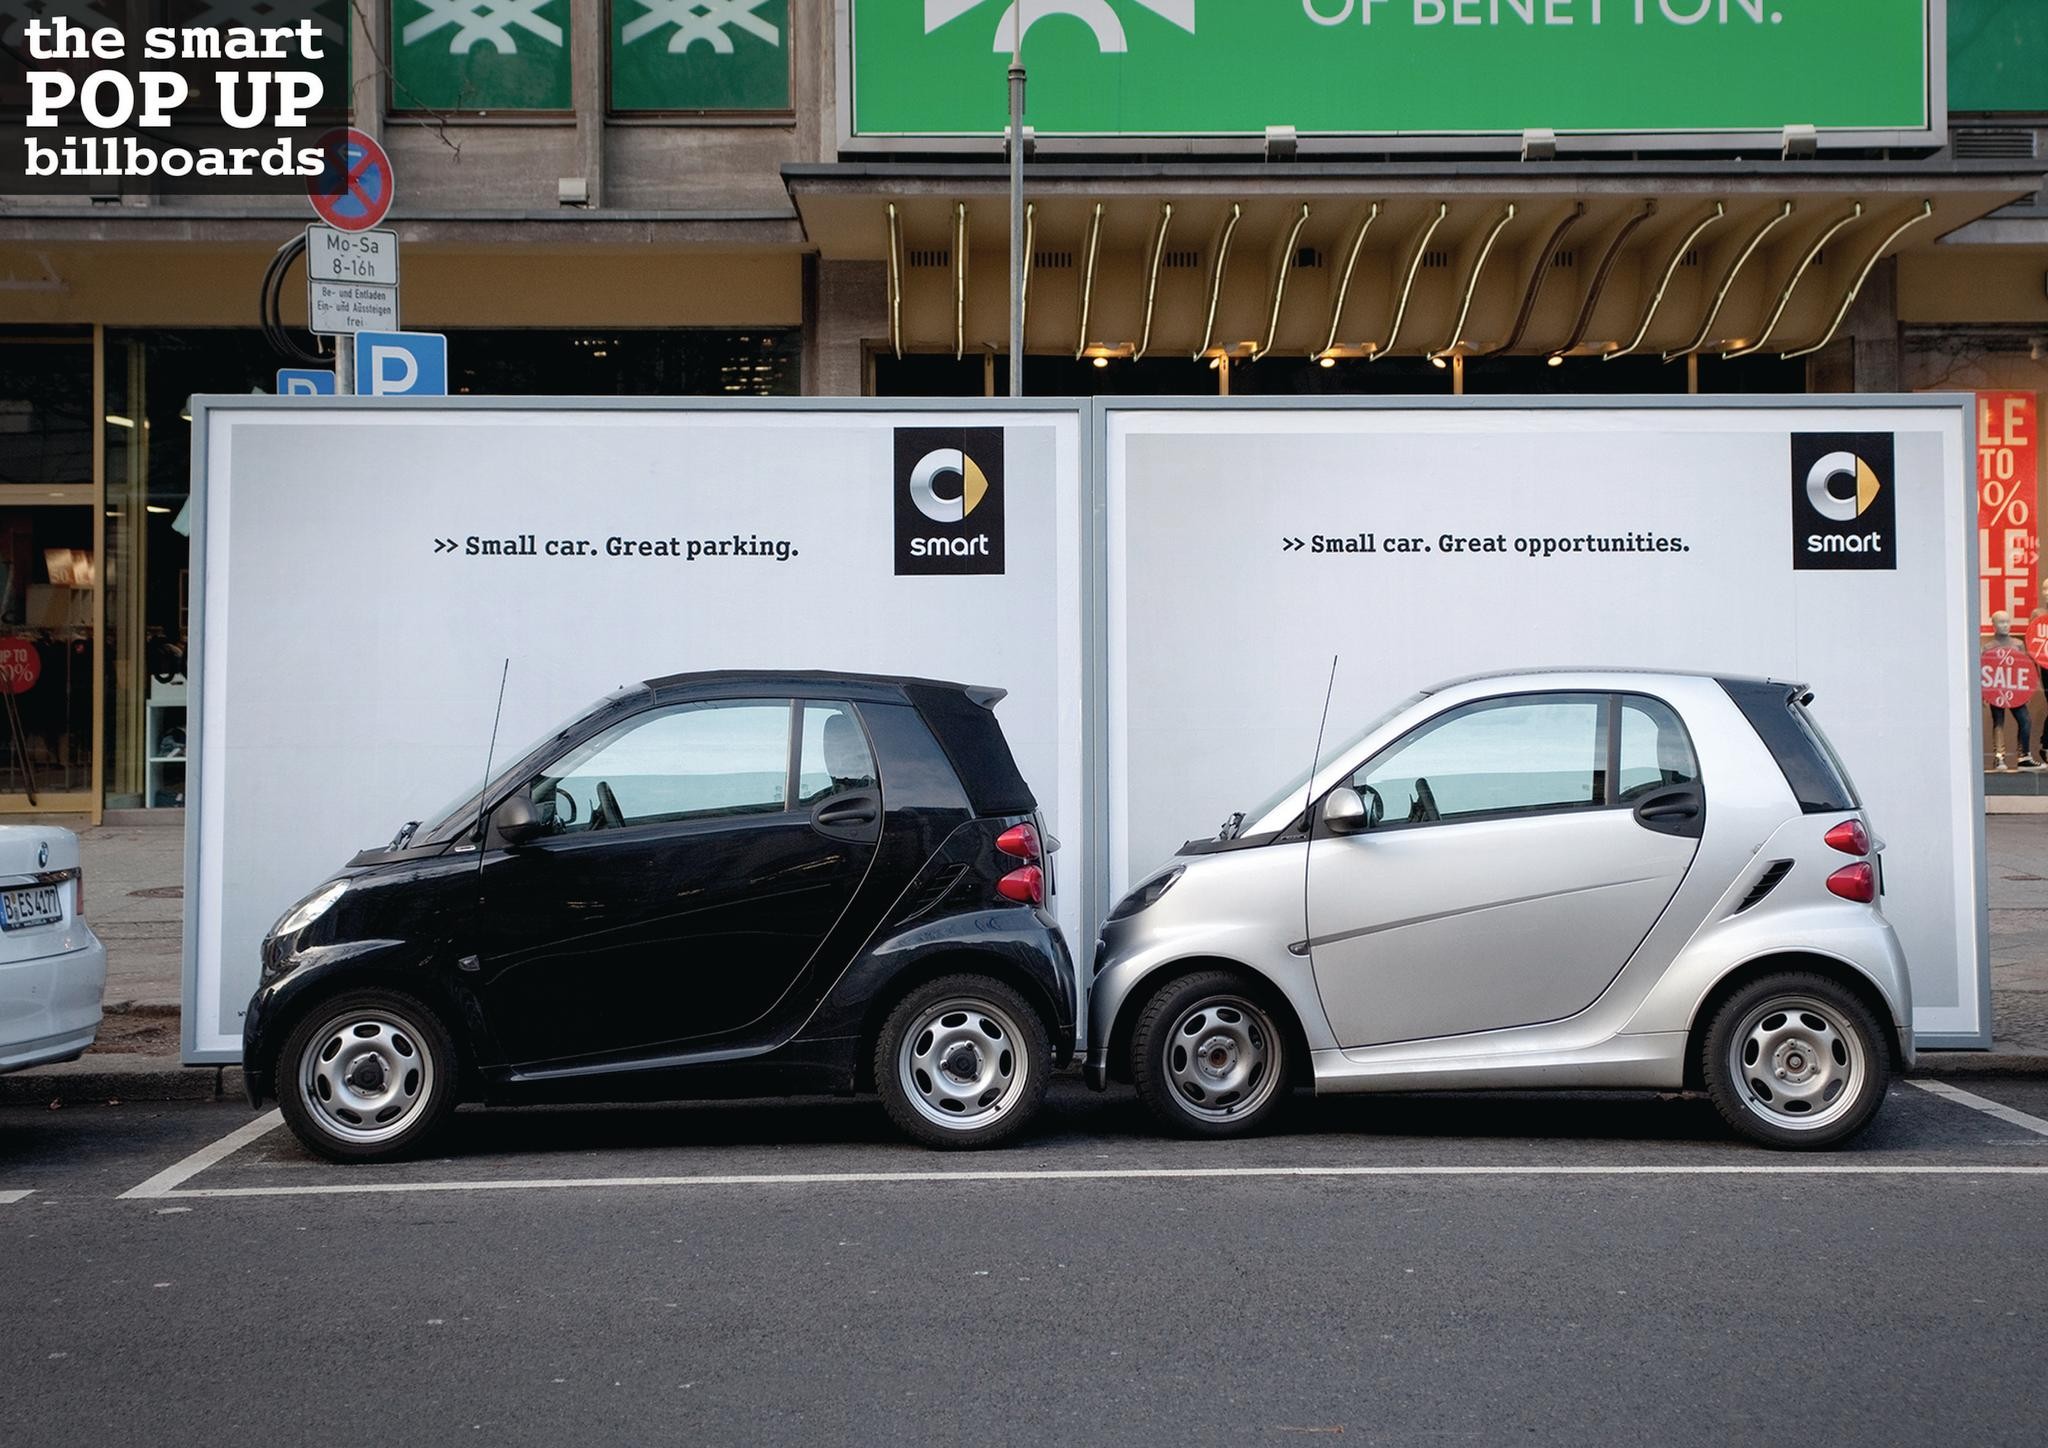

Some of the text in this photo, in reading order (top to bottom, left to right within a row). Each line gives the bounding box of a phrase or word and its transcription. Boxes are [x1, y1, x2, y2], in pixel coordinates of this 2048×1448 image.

[327, 234, 379, 254] Mo-Sa
[333, 258, 375, 277] 8-16h
[339, 288, 352, 299] und
[355, 288, 386, 301] Entladen
[347, 315, 364, 327] frei
[372, 345, 418, 395] P
[1979, 448, 2014, 480] TO
[465, 534, 537, 556] Small
[545, 540, 598, 556] car.
[605, 536, 681, 557] Great
[686, 534, 799, 561] parking.
[910, 533, 989, 556] smart
[1311, 533, 1376, 554] Small
[1383, 537, 1431, 553] car.
[1438, 533, 1507, 553] Great
[1514, 532, 1690, 557] opportunities.
[1807, 531, 1882, 553] smart
[2036, 623, 2048, 638] U
[1981, 665, 2030, 690] SALE
[3, 888, 57, 919] B ES 4177
